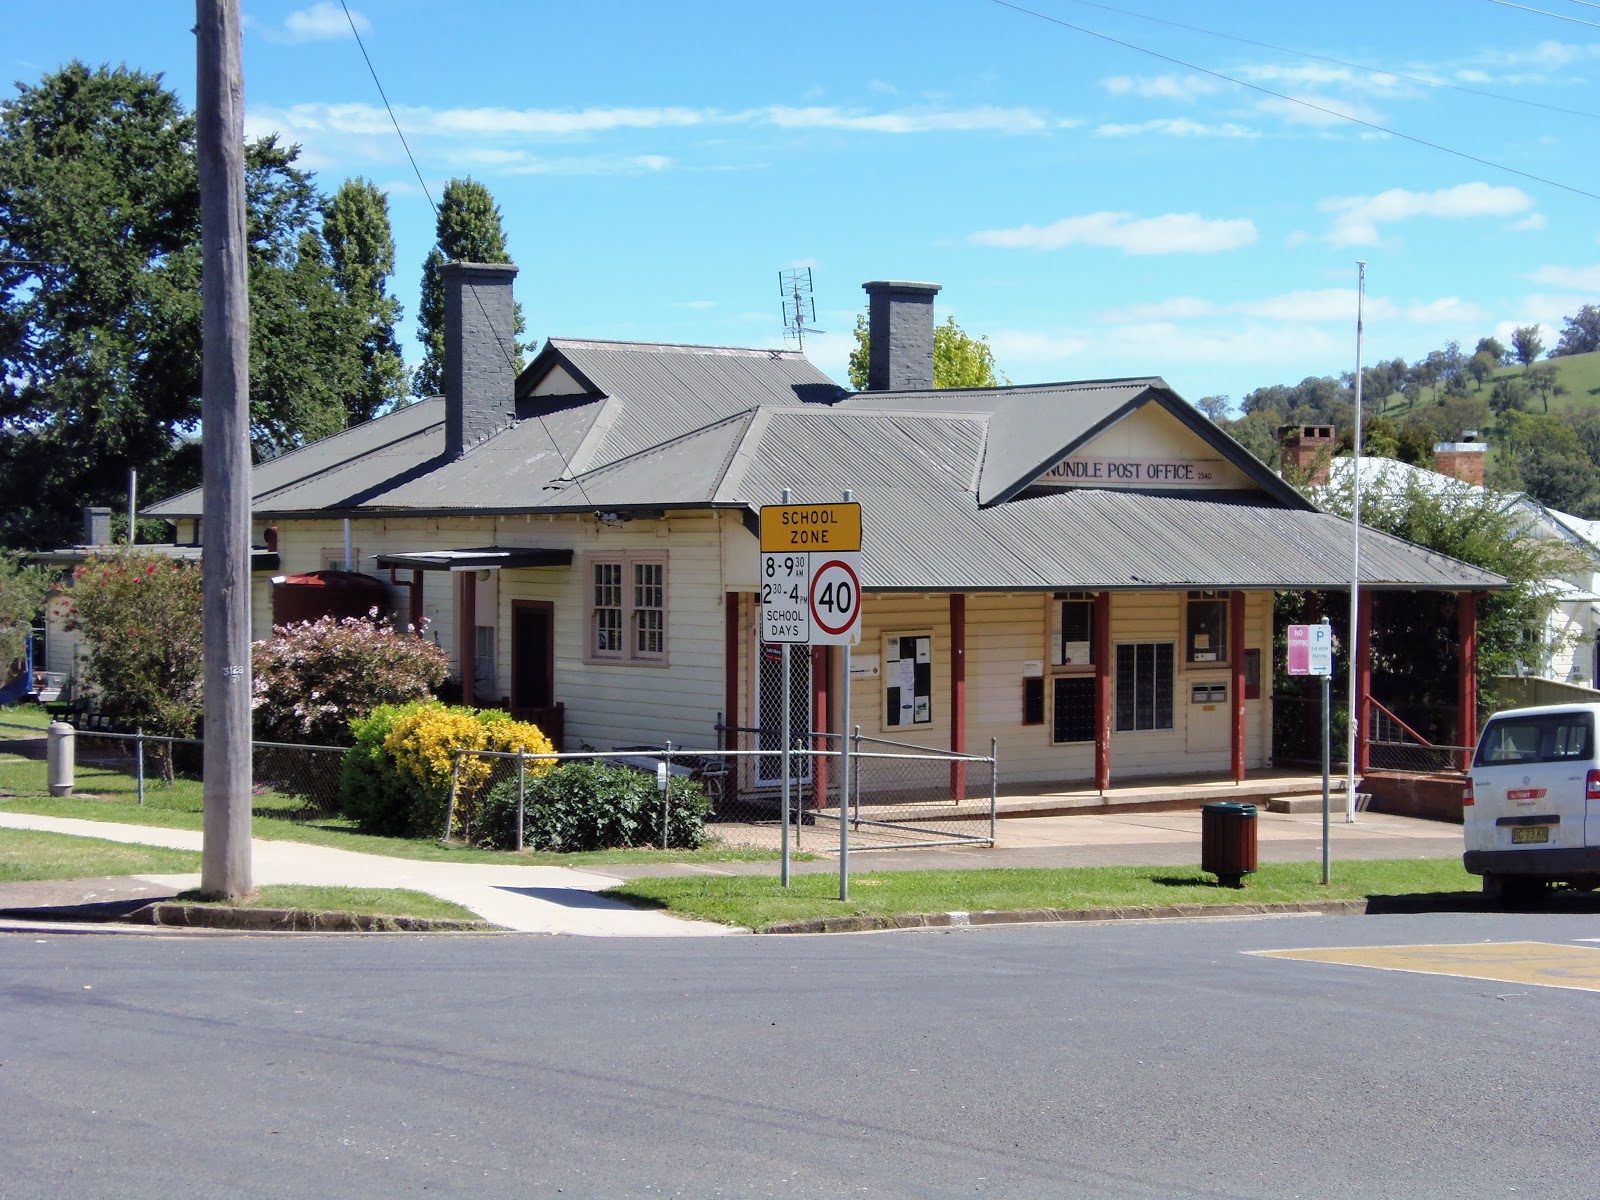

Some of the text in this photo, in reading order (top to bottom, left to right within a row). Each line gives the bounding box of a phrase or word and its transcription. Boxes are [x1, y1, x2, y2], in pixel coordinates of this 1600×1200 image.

[1108, 463, 1143, 479] POST
[1147, 464, 1194, 480] OFFICE
[1197, 472, 1213, 480] 2340
[782, 510, 837, 525] SCHOOL
[790, 530, 829, 544] ZONE
[818, 581, 852, 614] 40
[766, 610, 804, 622] SCHOOL
[771, 625, 799, 636] DAYS
[1316, 631, 1324, 642] P
